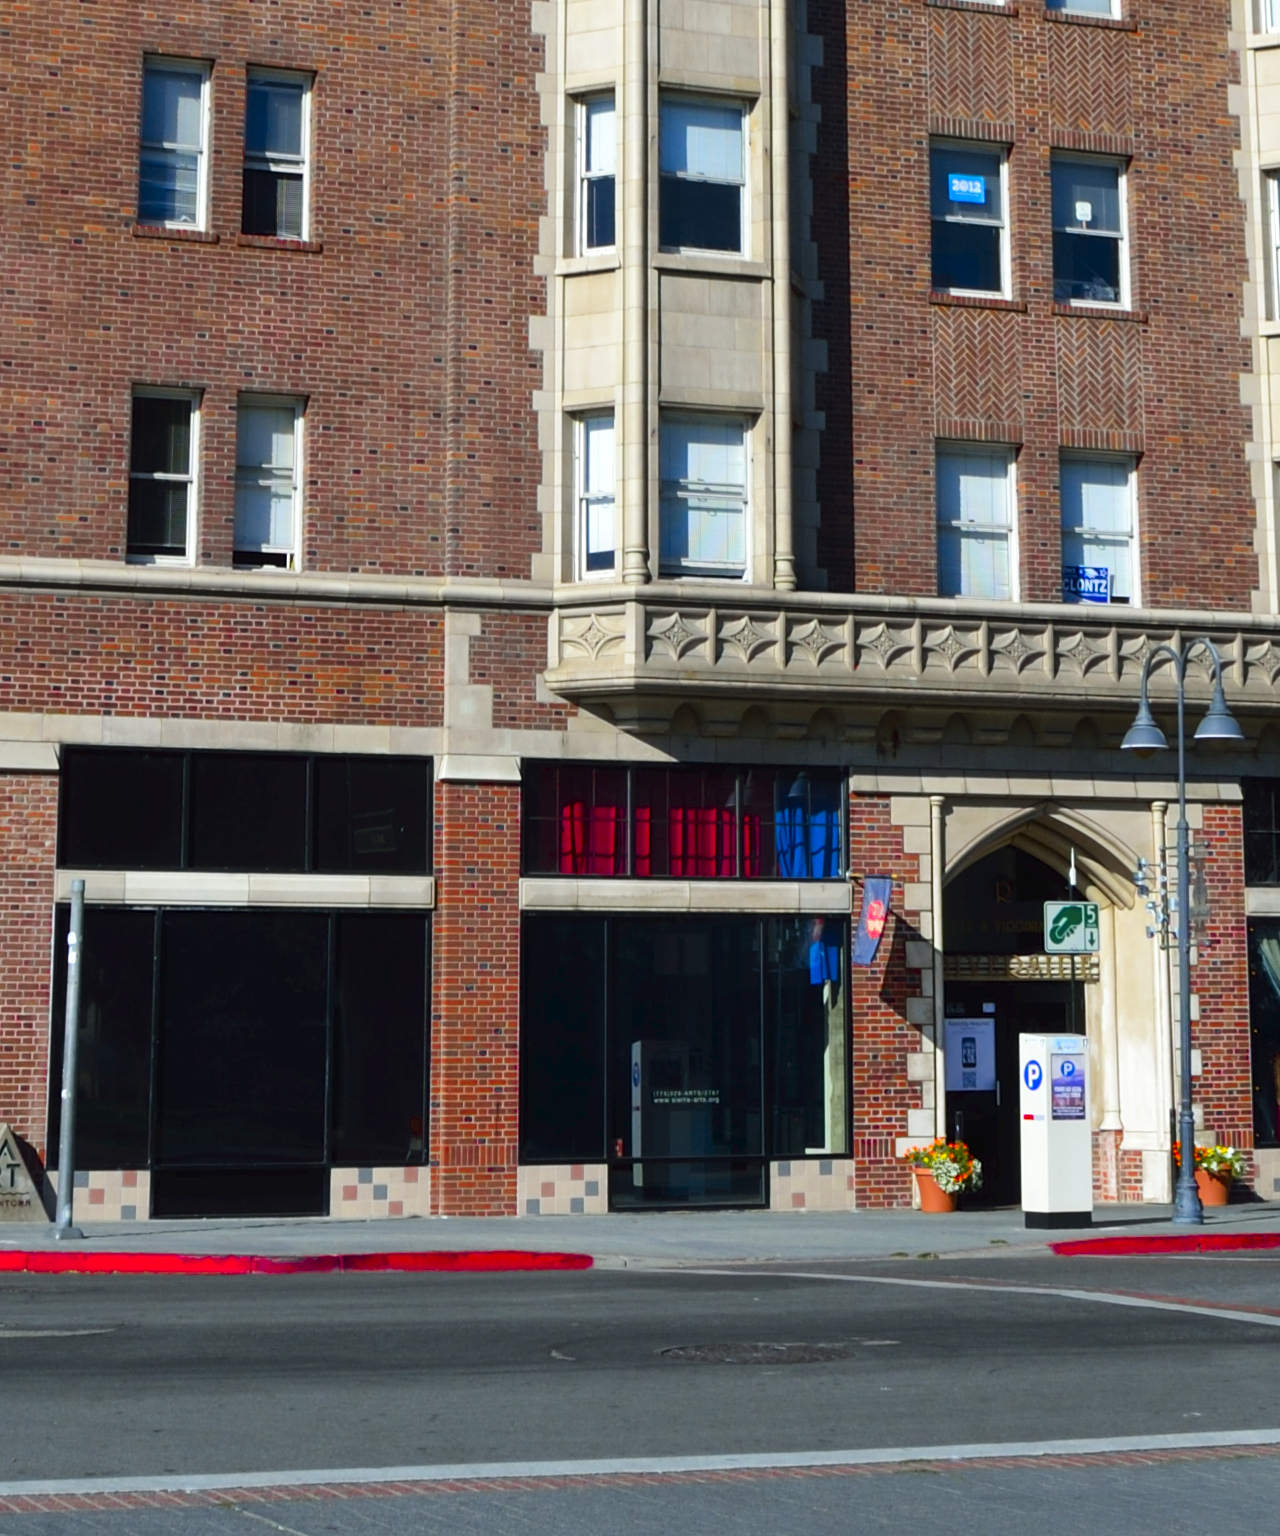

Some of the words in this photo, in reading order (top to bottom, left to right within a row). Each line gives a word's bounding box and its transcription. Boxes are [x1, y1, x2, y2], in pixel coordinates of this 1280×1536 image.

[952, 179, 982, 193] 2012
[1064, 578, 1107, 593] CLONTZ
[1086, 905, 1096, 923] 5
